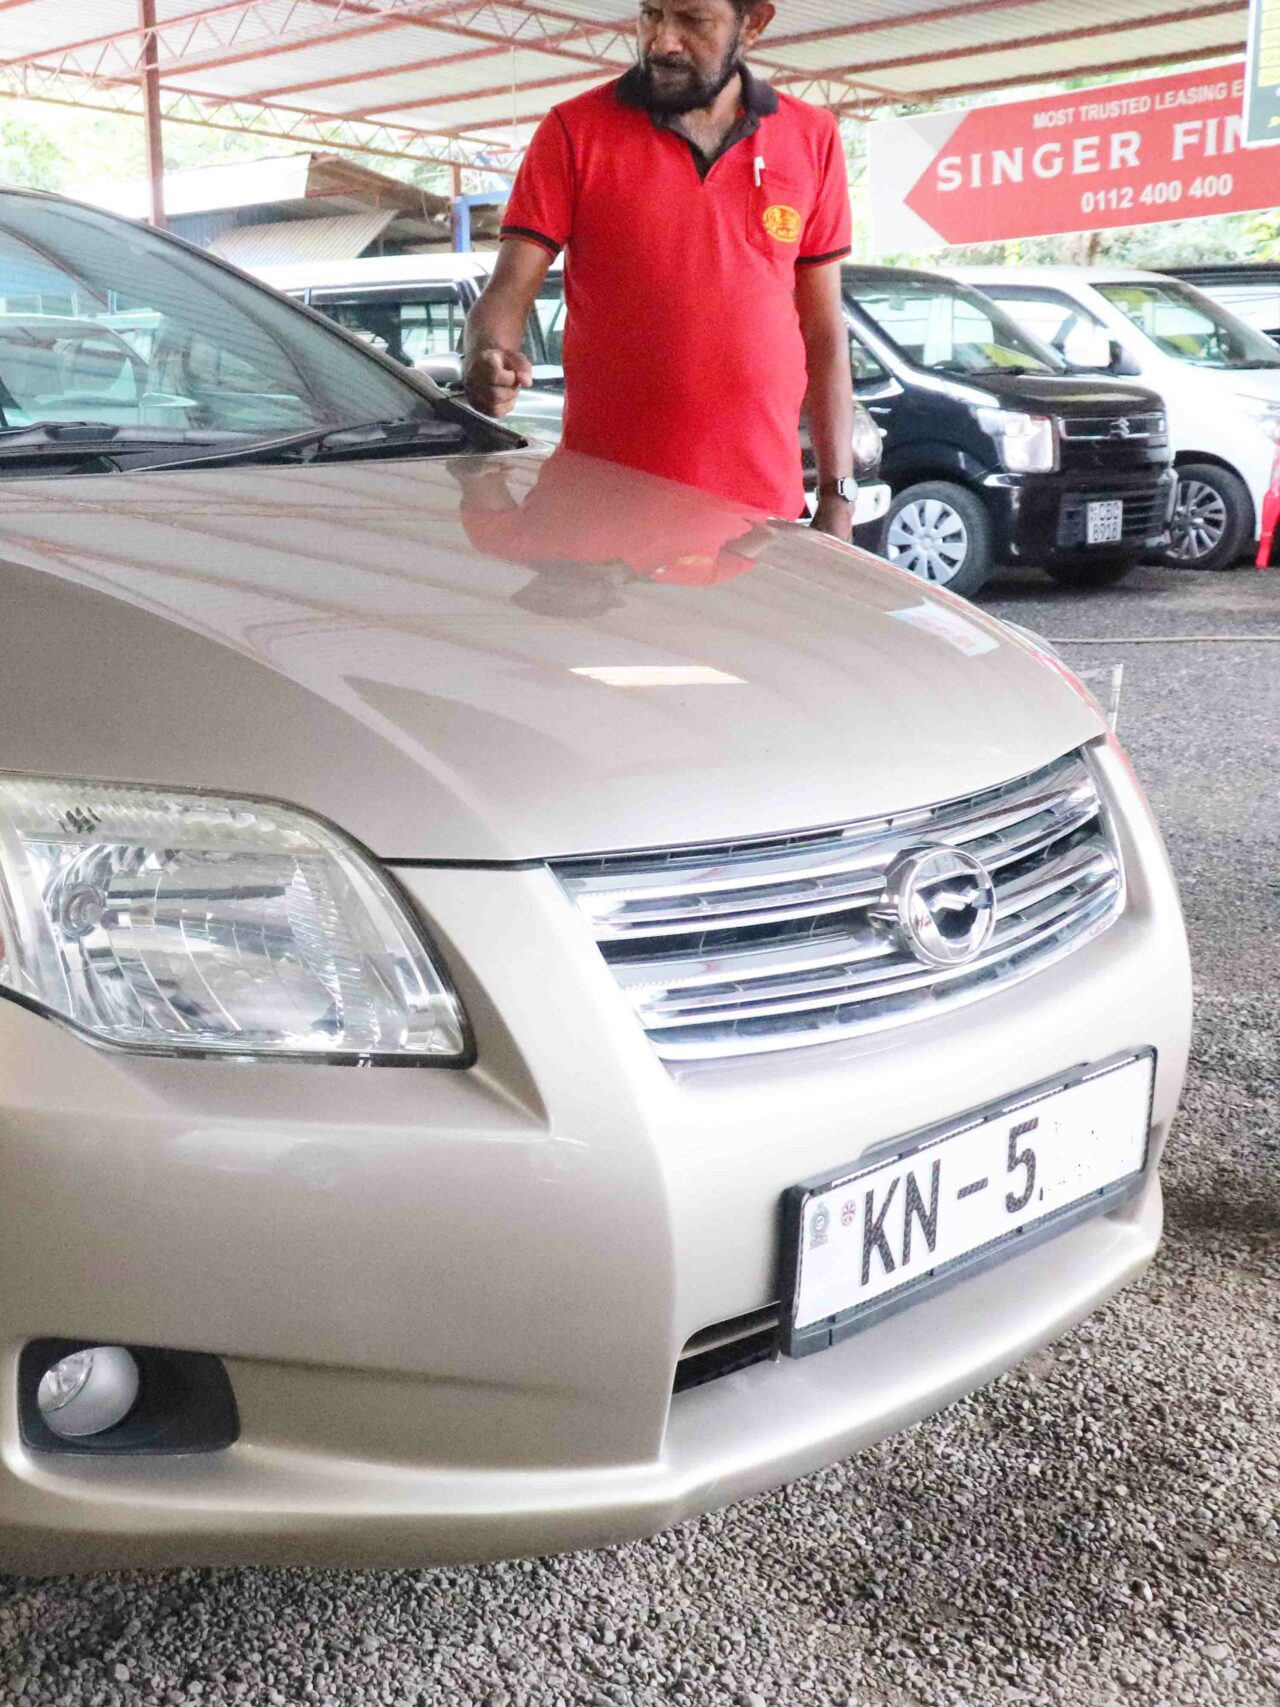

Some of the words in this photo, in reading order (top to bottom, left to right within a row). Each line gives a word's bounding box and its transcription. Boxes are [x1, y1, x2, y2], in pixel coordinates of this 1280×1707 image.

[1032, 107, 1076, 129] MOST
[1079, 95, 1151, 122] TRUSTED
[1154, 82, 1228, 111] LEASING
[935, 130, 1143, 192] SINGER
[1080, 186, 1134, 214] 0112
[1138, 180, 1182, 206] 400
[1188, 173, 1233, 199] 400
